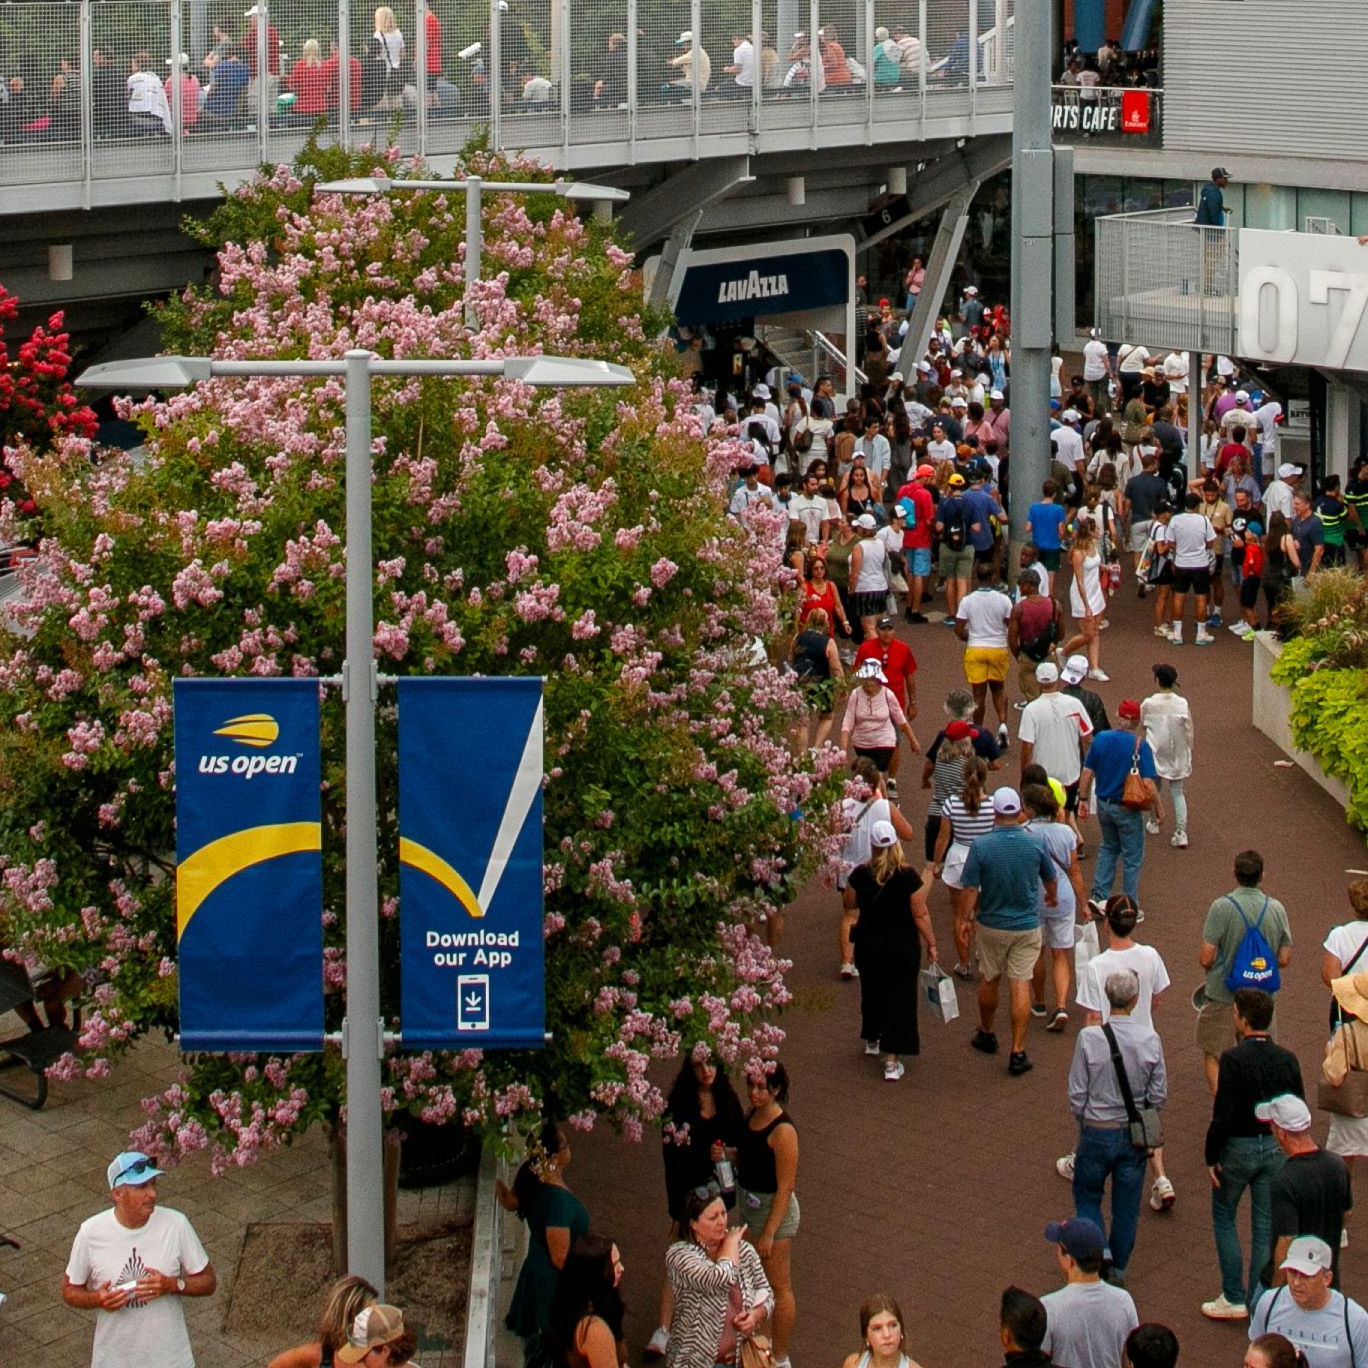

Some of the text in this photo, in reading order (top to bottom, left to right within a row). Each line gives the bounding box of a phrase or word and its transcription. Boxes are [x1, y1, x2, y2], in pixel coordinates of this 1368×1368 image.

[1051, 104, 1117, 131] RTS CAFE
[882, 209, 892, 224] 6
[717, 269, 789, 304] LAVAZZA
[199, 755, 230, 773] us
[232, 755, 298, 779] open
[426, 929, 520, 948] Download
[434, 948, 512, 968] our App
